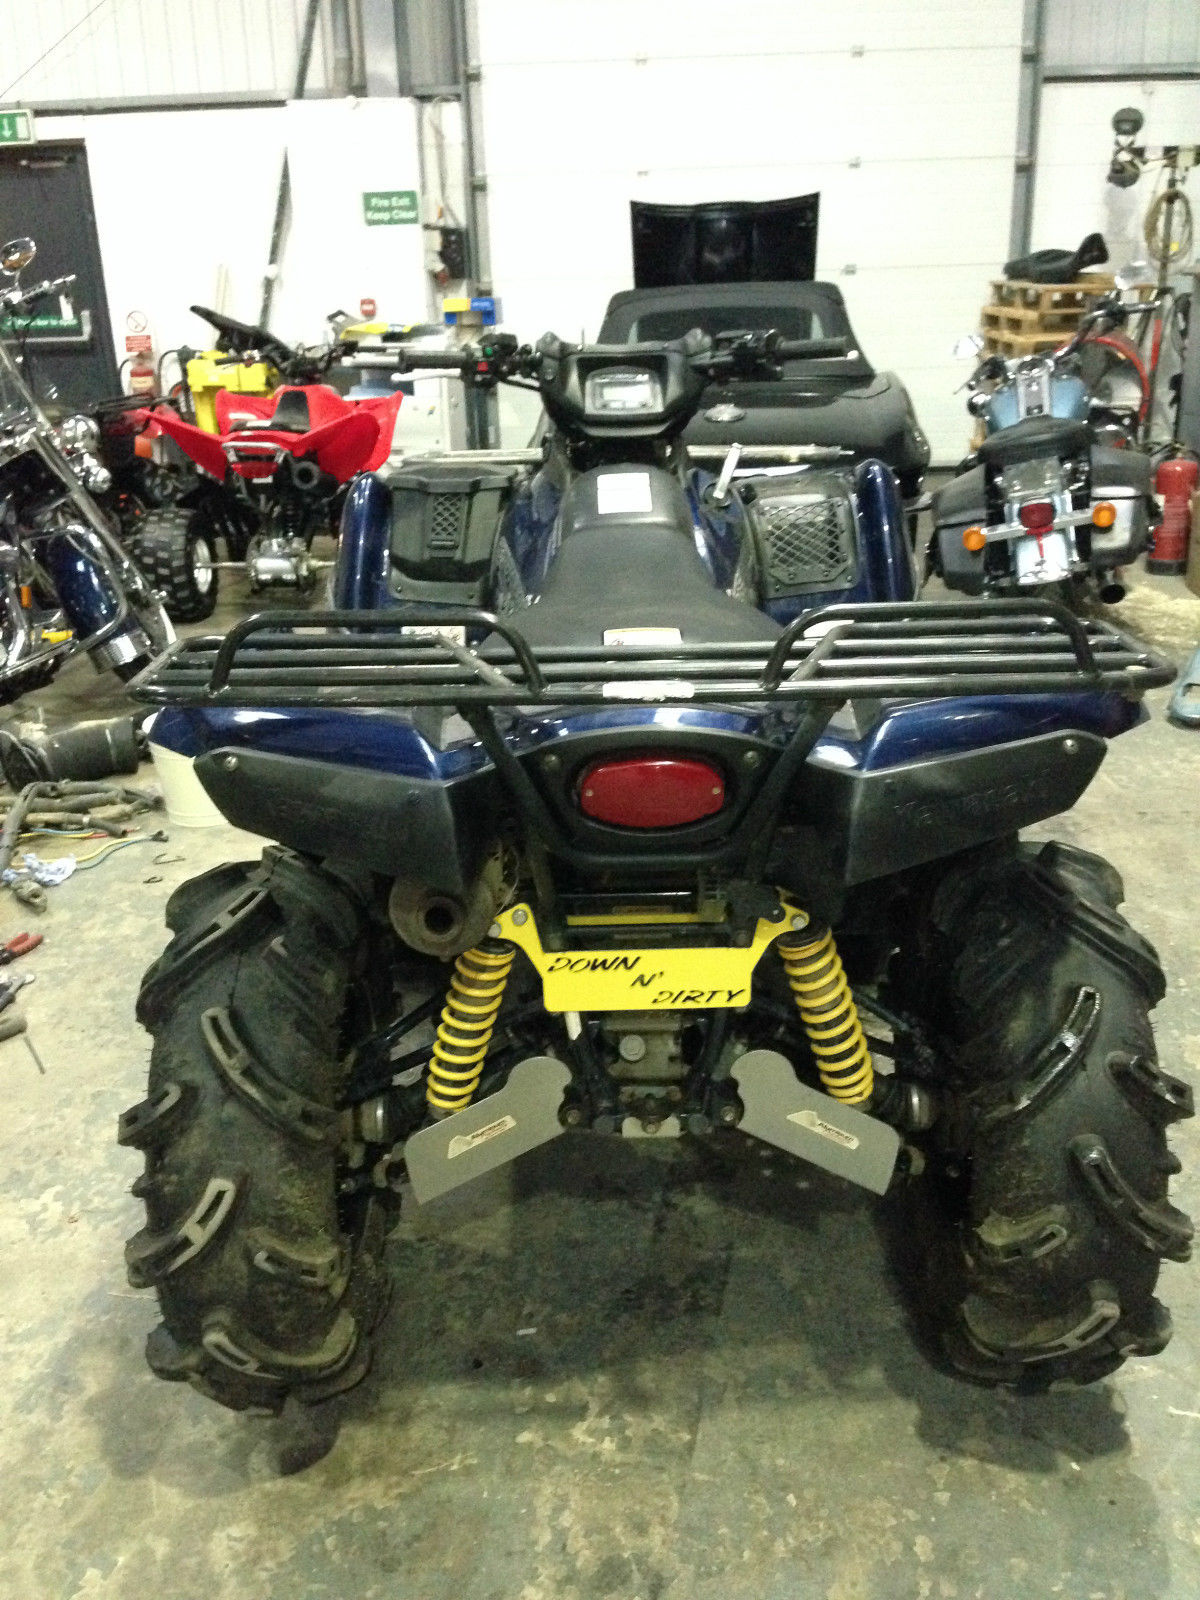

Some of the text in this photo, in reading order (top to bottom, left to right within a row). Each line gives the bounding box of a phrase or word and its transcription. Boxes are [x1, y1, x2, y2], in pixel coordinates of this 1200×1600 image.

[547, 956, 641, 973] DOWN
[630, 971, 664, 987] N'
[651, 988, 746, 1004] DIRTY
